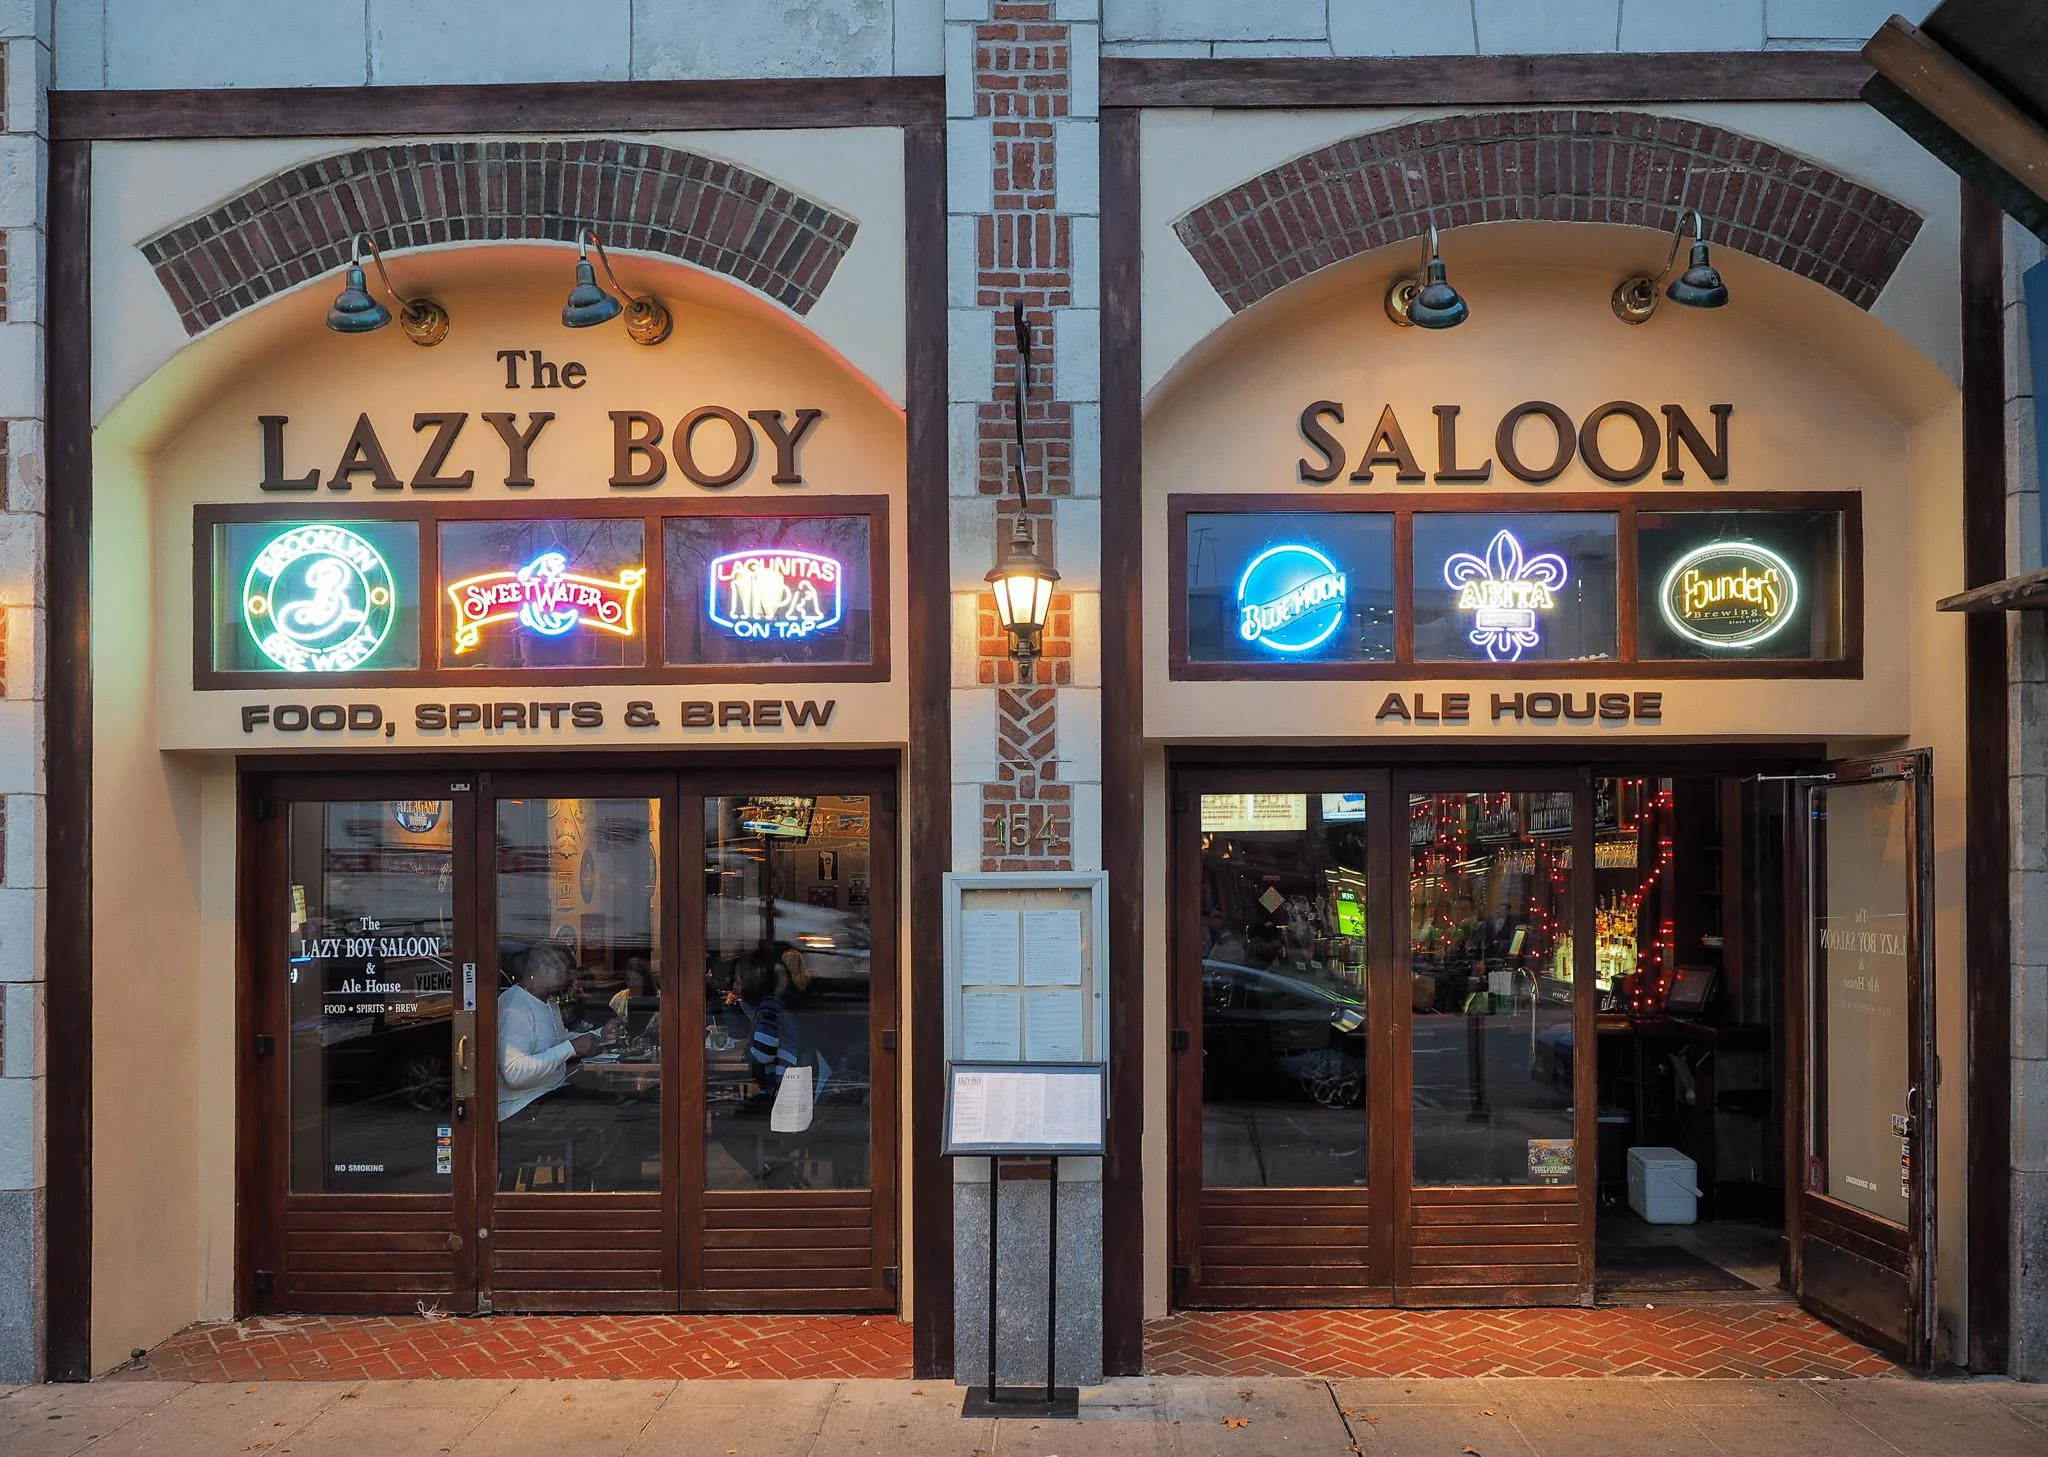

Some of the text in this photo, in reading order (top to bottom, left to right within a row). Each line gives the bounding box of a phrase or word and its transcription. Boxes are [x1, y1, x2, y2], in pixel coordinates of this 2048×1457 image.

[498, 351, 586, 389] The
[258, 406, 821, 490] LAZY BOY
[1300, 401, 1733, 482] SALOON
[256, 530, 378, 577] BROOKLYN
[718, 557, 835, 582] LAGUNITAS
[1458, 580, 1554, 608] ABITA
[1241, 576, 1346, 640] BLUE MOON
[1693, 608, 1759, 619] Brewing
[734, 620, 816, 638] ON TAP
[263, 625, 377, 671] BREWERY
[242, 700, 836, 737] FOOD, SPIRITS & BREW
[1376, 692, 1662, 719] ALE HOUSE
[992, 813, 1059, 847] 154
[360, 916, 380, 931] The
[301, 937, 440, 958] LAZY BOY SALOON
[365, 962, 375, 975] &
[465, 964, 473, 984] Pull
[341, 979, 401, 993] Ale House
[324, 1003, 418, 1014] FOOD SPIRITS BREW
[335, 1164, 384, 1172] NO SMOKING
